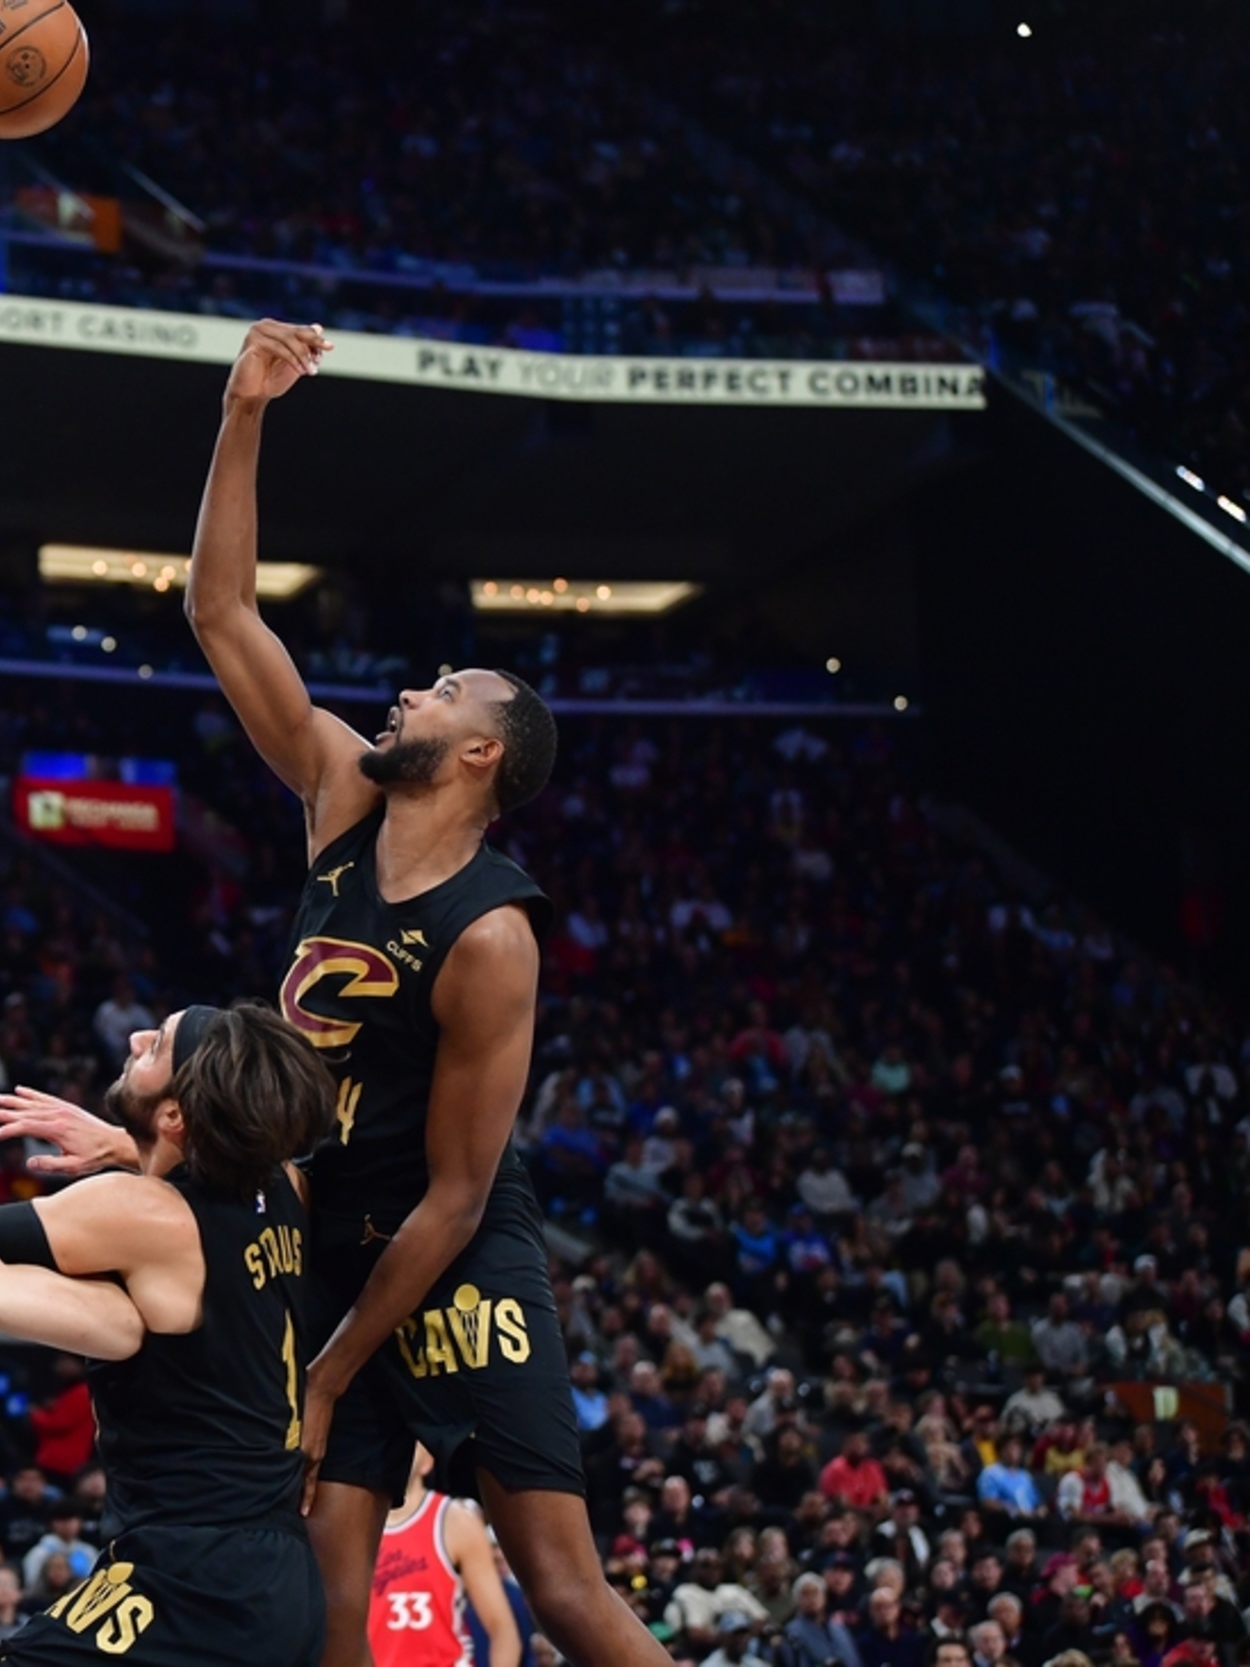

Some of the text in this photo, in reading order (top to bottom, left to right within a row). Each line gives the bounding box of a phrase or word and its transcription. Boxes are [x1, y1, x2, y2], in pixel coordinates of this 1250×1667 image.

[76, 314, 198, 347] CASINO
[417, 349, 502, 379] PLAY
[517, 359, 613, 389] YOUR
[628, 366, 791, 394] PERFECT
[386, 940, 423, 971] CLIFFS
[395, 1297, 531, 1379] CAVS
[387, 1591, 433, 1631] 33
